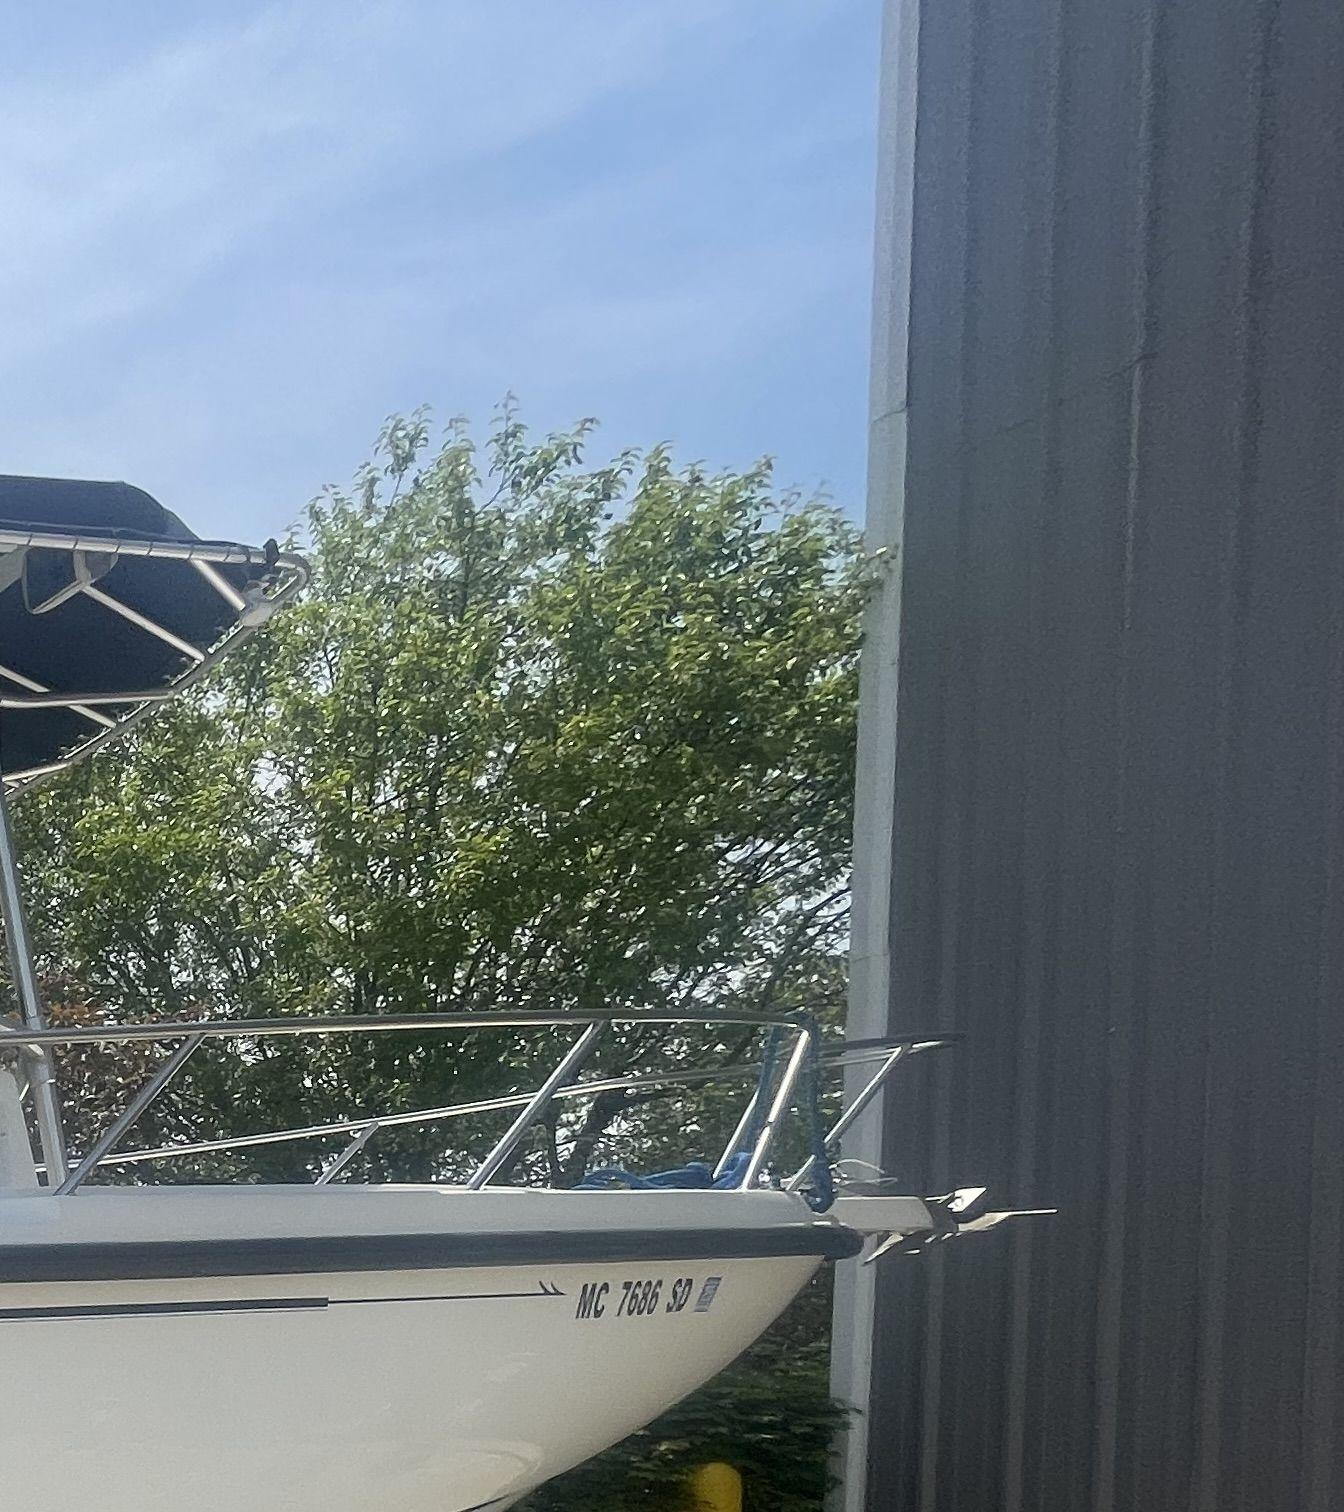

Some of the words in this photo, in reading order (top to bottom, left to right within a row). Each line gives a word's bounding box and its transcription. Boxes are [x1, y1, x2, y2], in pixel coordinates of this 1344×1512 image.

[575, 1282, 610, 1319] MC
[616, 1279, 663, 1317] 7686
[666, 1278, 693, 1313] SD
